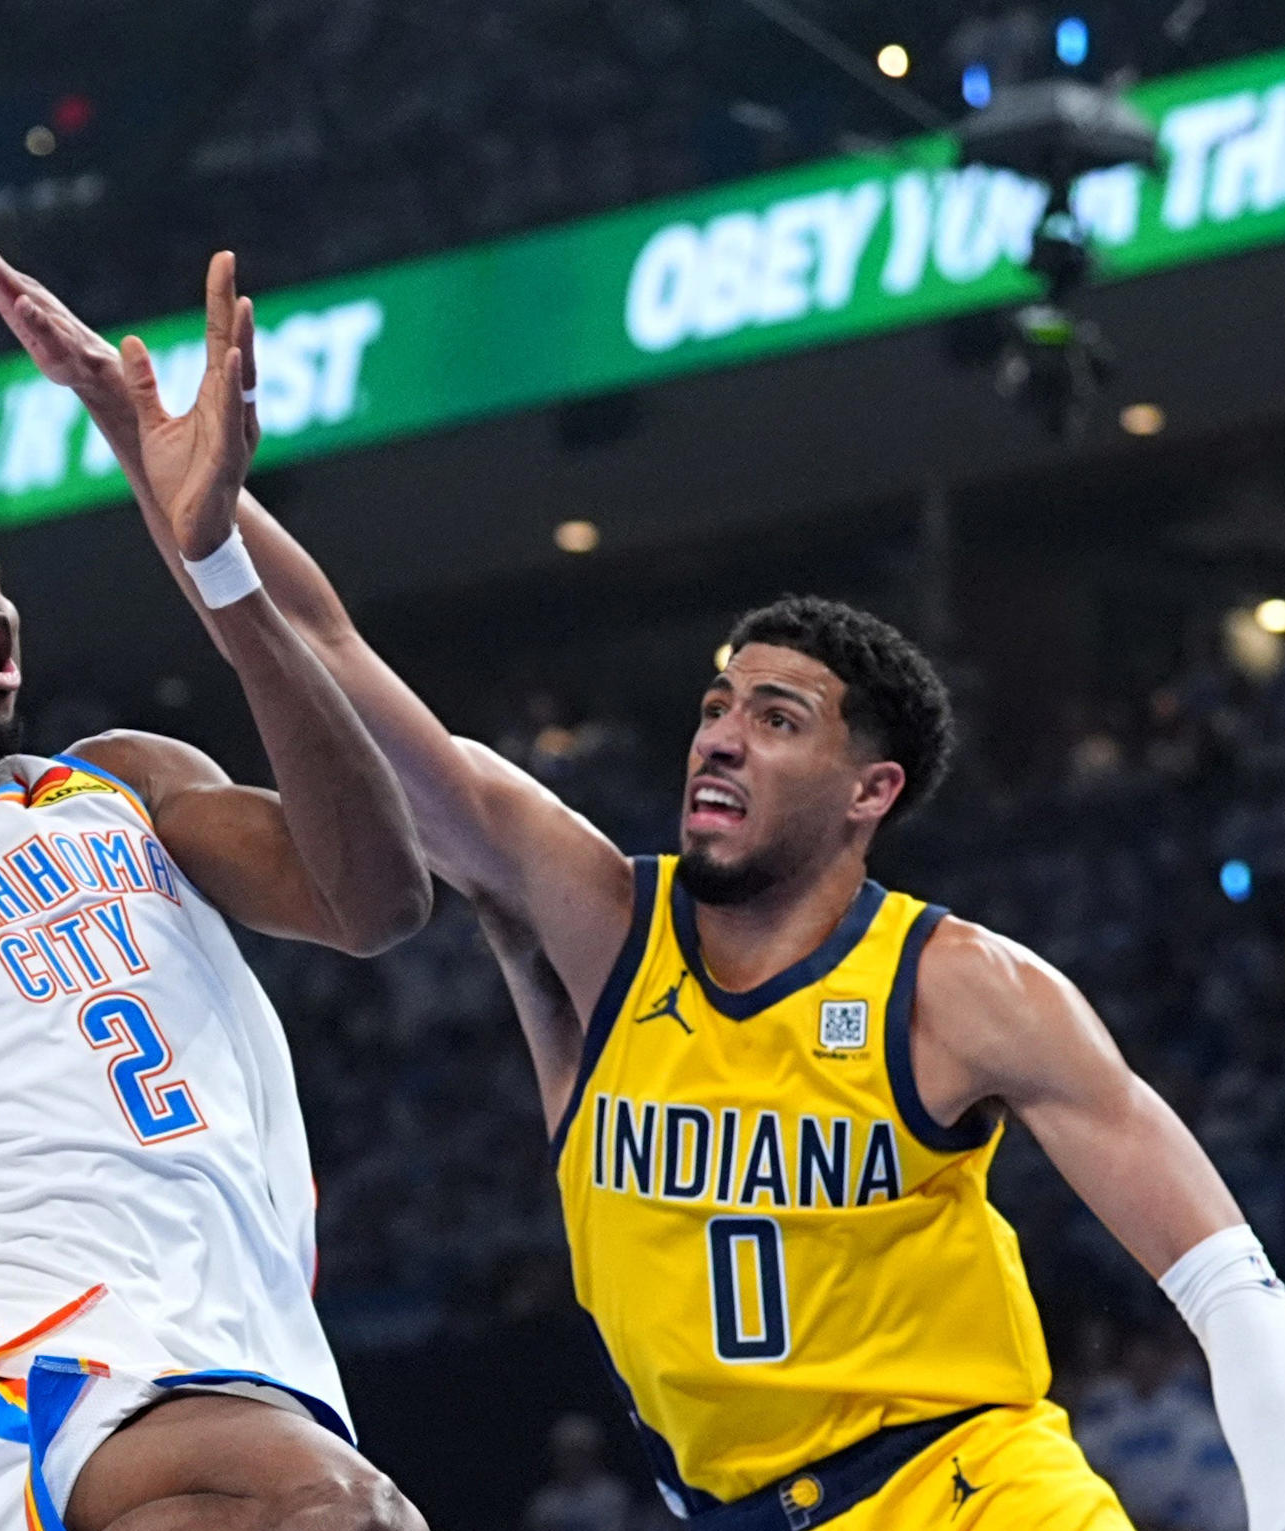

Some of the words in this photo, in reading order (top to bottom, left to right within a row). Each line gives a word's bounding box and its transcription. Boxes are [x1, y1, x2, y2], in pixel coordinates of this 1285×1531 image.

[624, 178, 886, 352] OBEY
[77, 990, 209, 1146] 2
[592, 1094, 903, 1209] INDIANA
[706, 1213, 792, 1364] 0
